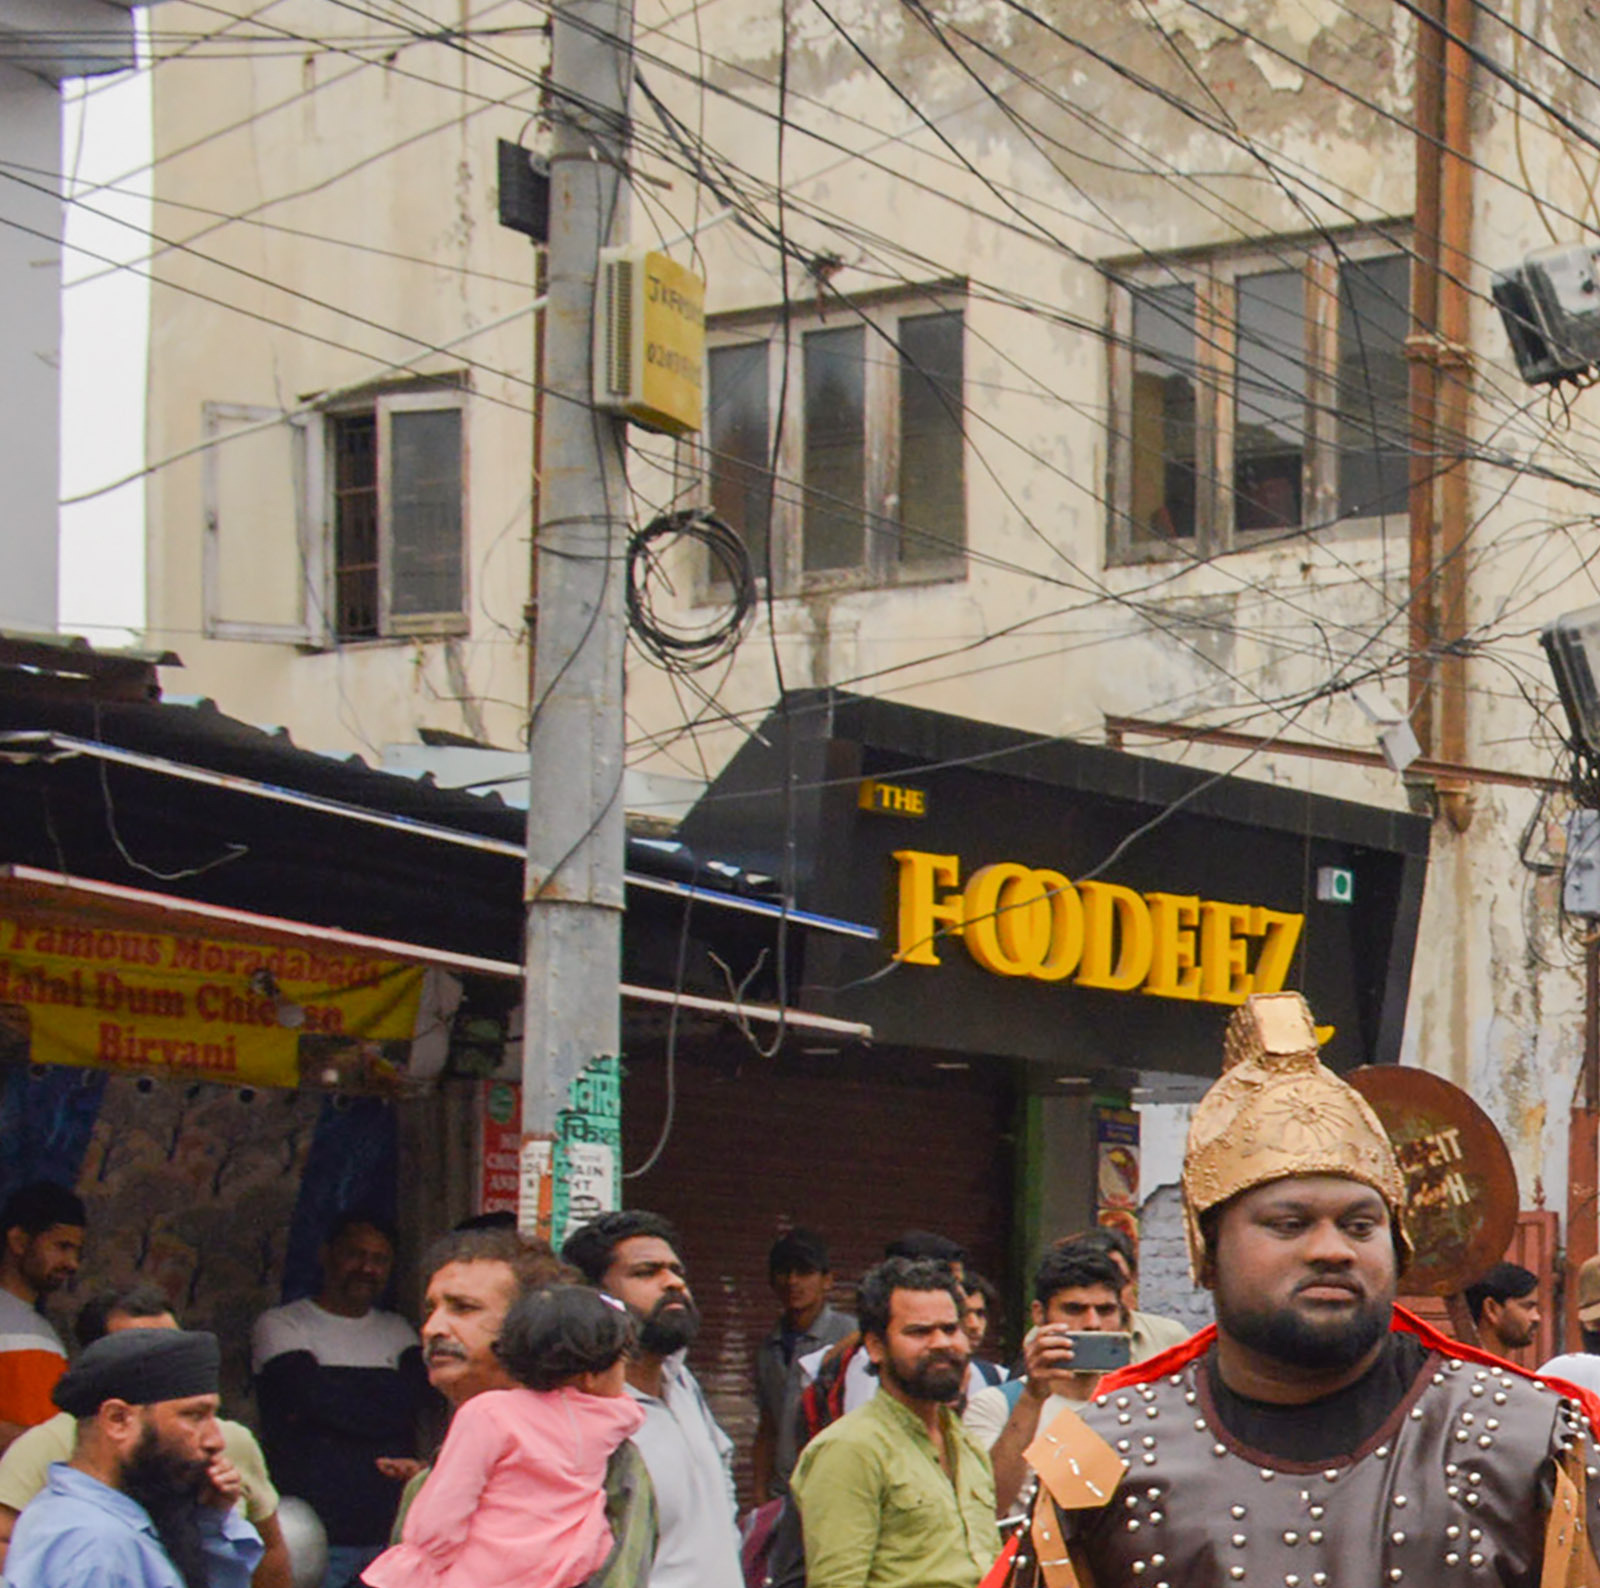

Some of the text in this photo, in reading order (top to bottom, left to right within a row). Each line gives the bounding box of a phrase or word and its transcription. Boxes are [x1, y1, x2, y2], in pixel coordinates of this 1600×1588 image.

[875, 783, 925, 814] THE
[11, 919, 162, 966] Famous
[893, 850, 1336, 1045] FOODEEZ
[98, 974, 187, 1020] Dum
[198, 982, 345, 1034] Chicen
